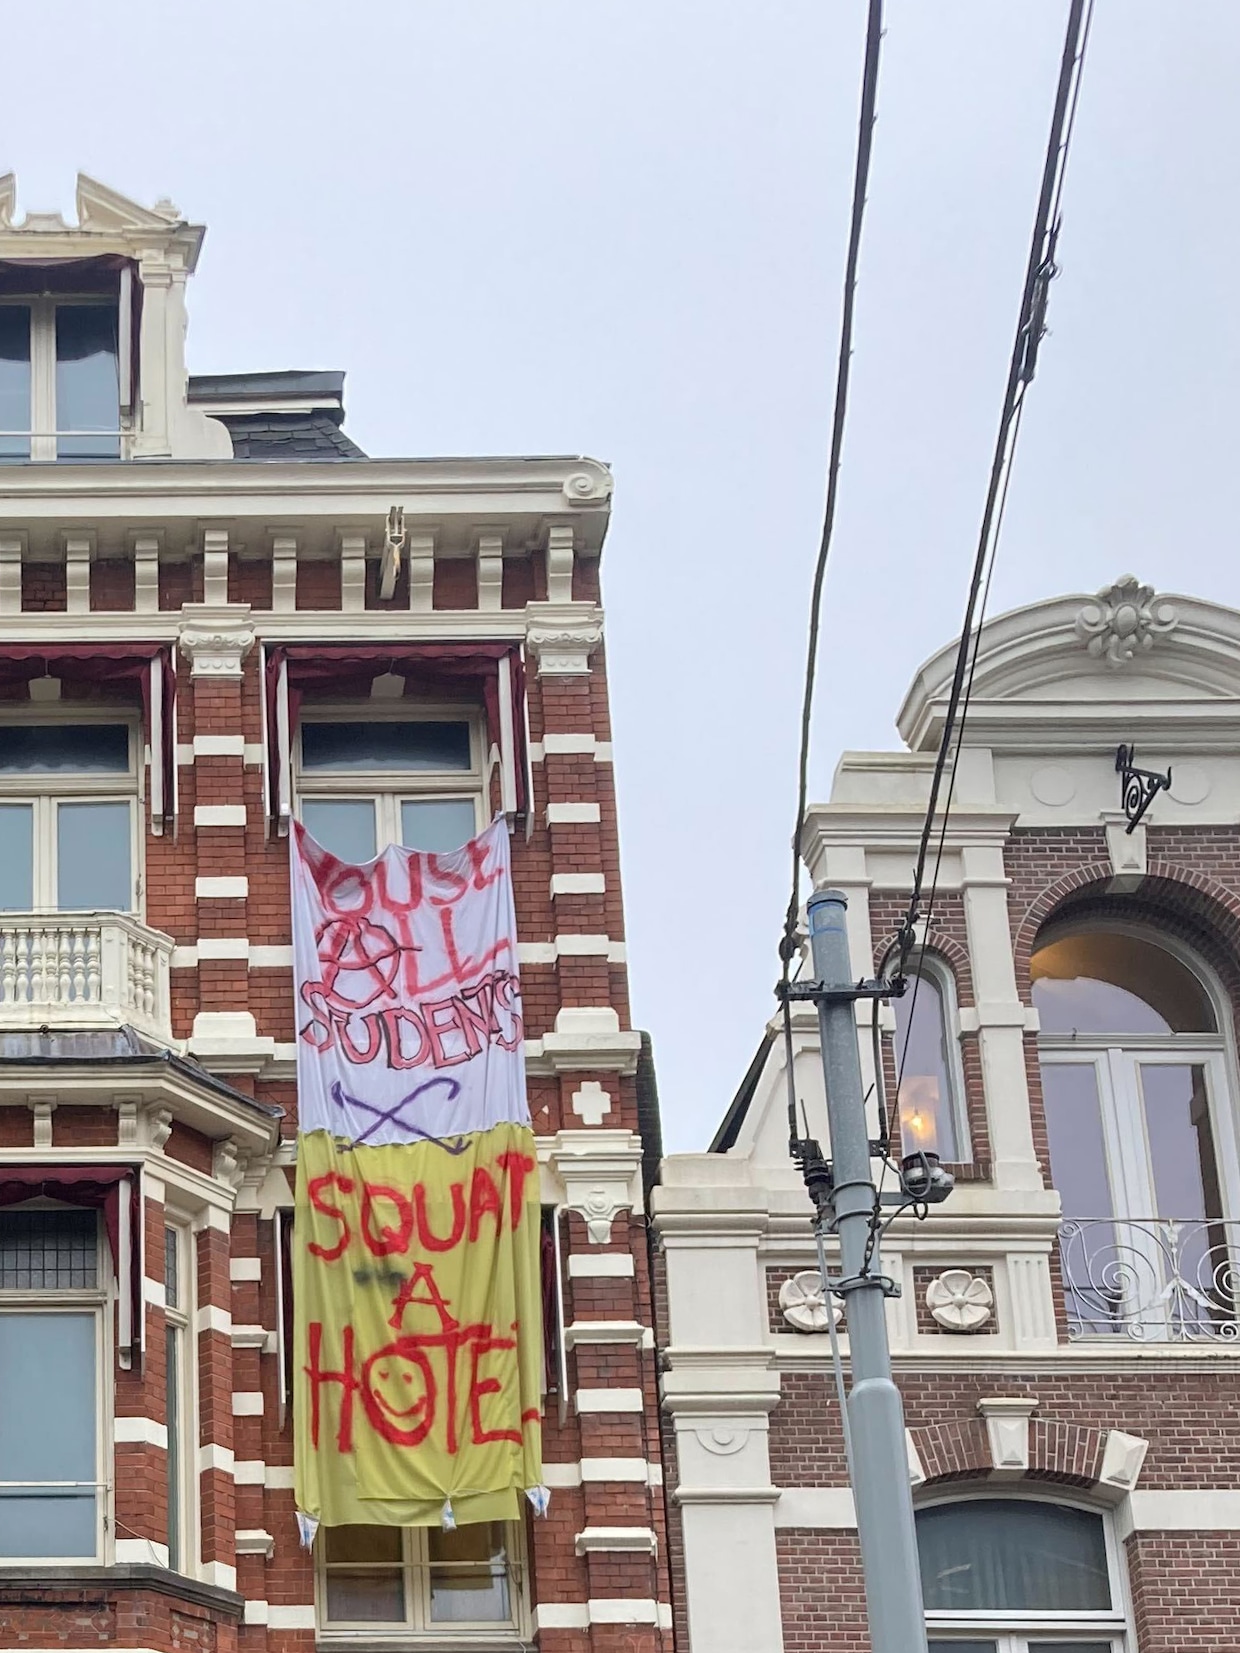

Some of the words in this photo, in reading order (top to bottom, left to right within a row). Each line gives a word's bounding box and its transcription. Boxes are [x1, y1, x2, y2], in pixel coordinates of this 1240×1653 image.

[307, 1151, 536, 1262] SQUAT
[388, 1262, 458, 1331] A
[304, 1320, 541, 1455] HOTE
